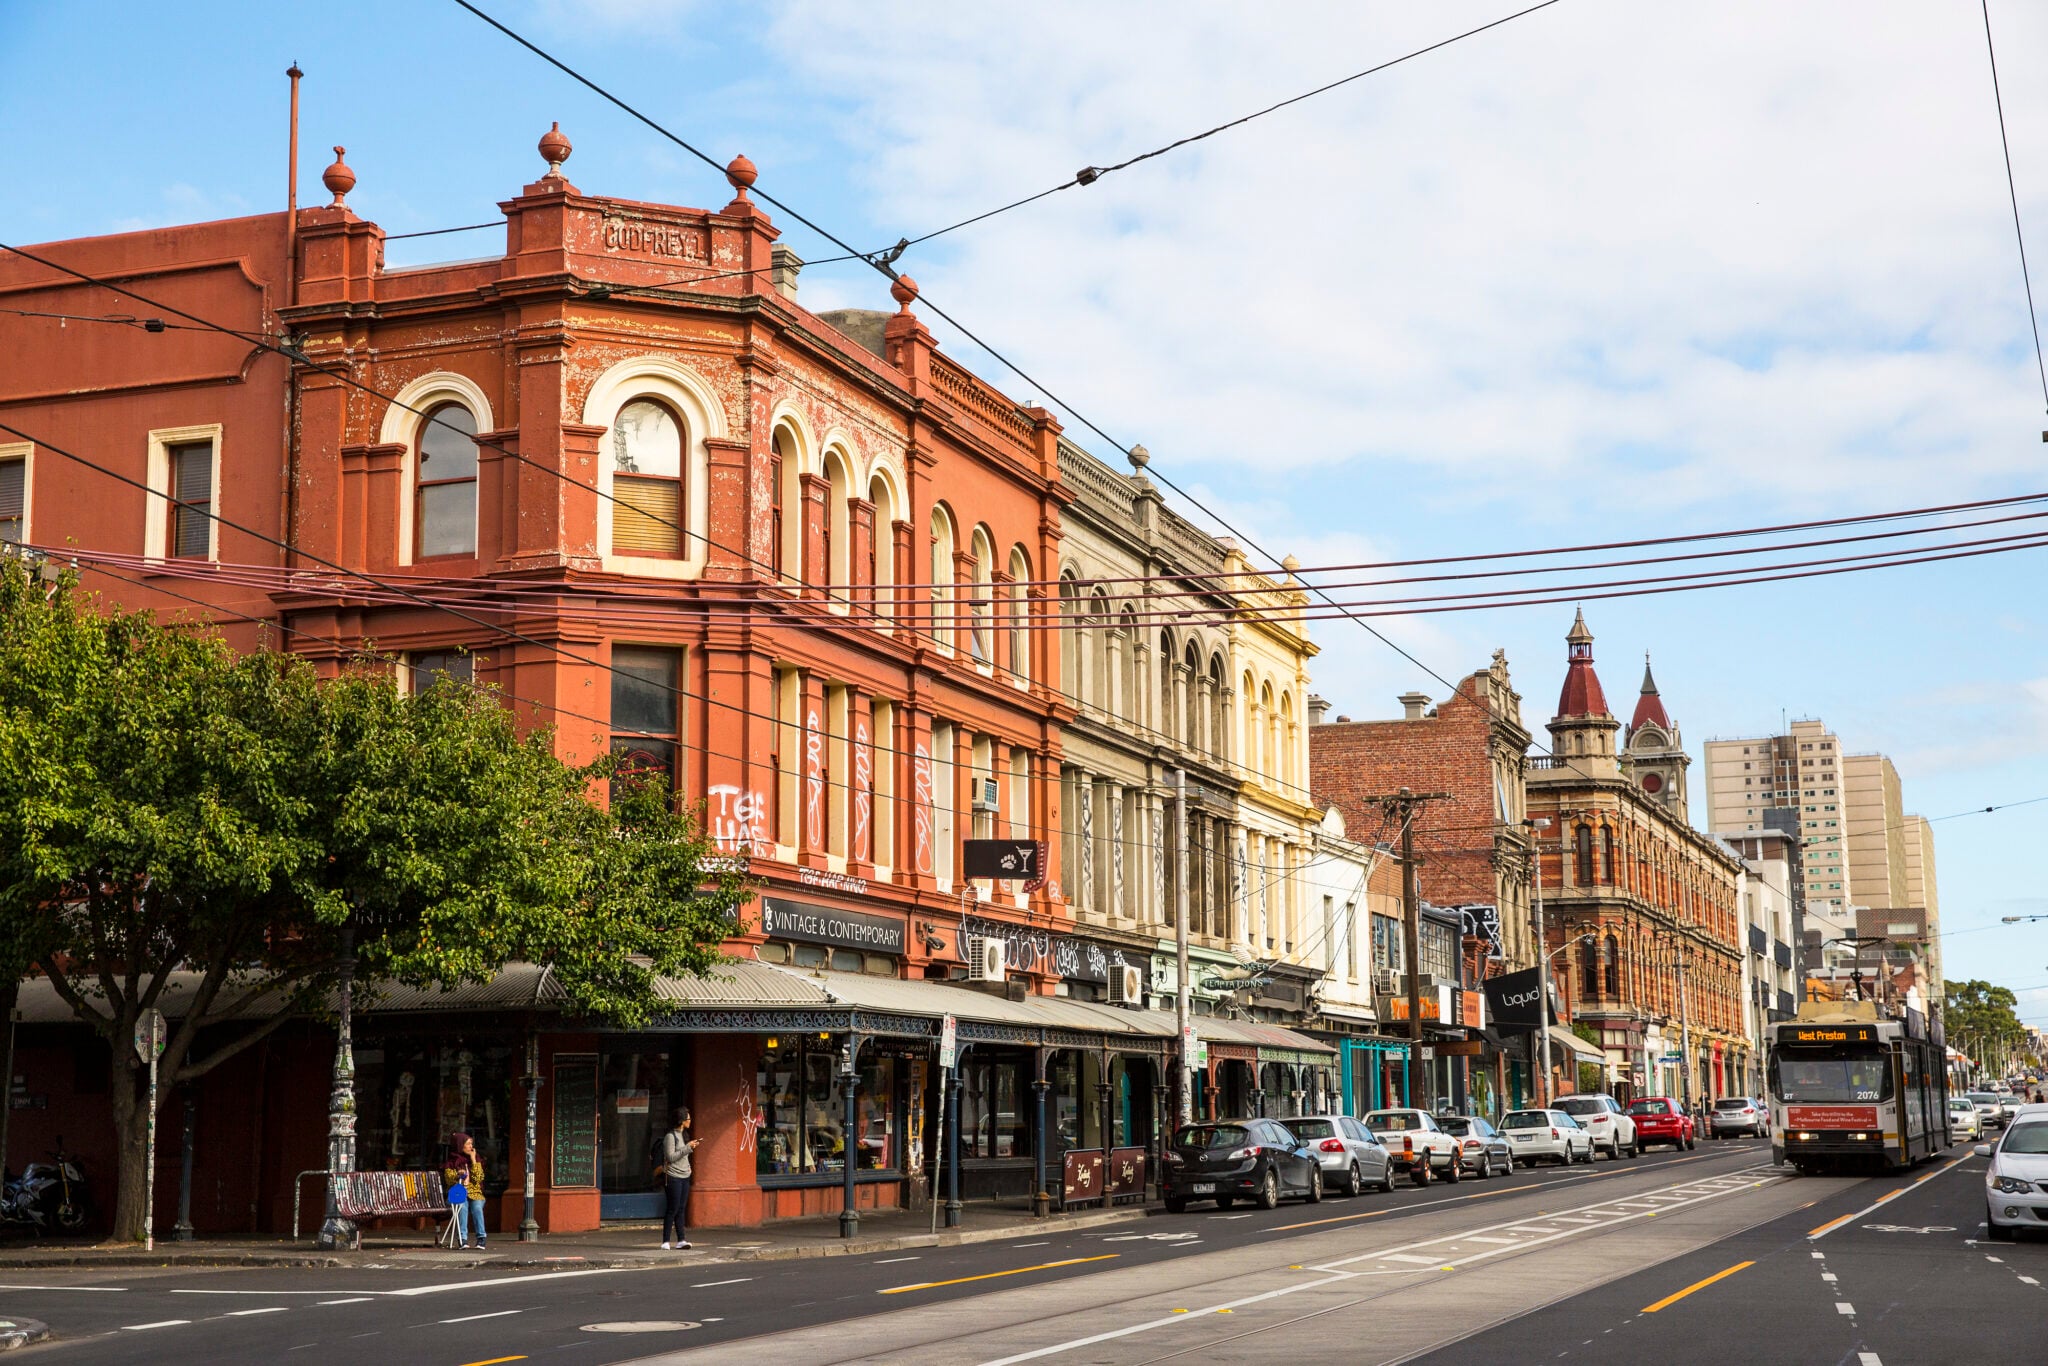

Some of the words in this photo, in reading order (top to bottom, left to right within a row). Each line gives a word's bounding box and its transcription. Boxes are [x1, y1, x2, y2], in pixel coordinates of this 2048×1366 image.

[775, 911, 817, 935] VINTAGE
[819, 920, 826, 936] &
[828, 919, 900, 947] CONTEMPORARY
[1204, 979, 1264, 989] TEMPTATIONS
[1798, 1031, 1815, 1040] West
[1816, 1030, 1846, 1040] Preston
[1858, 1030, 1867, 1040] 11
[1857, 1091, 1879, 1100] 2076
